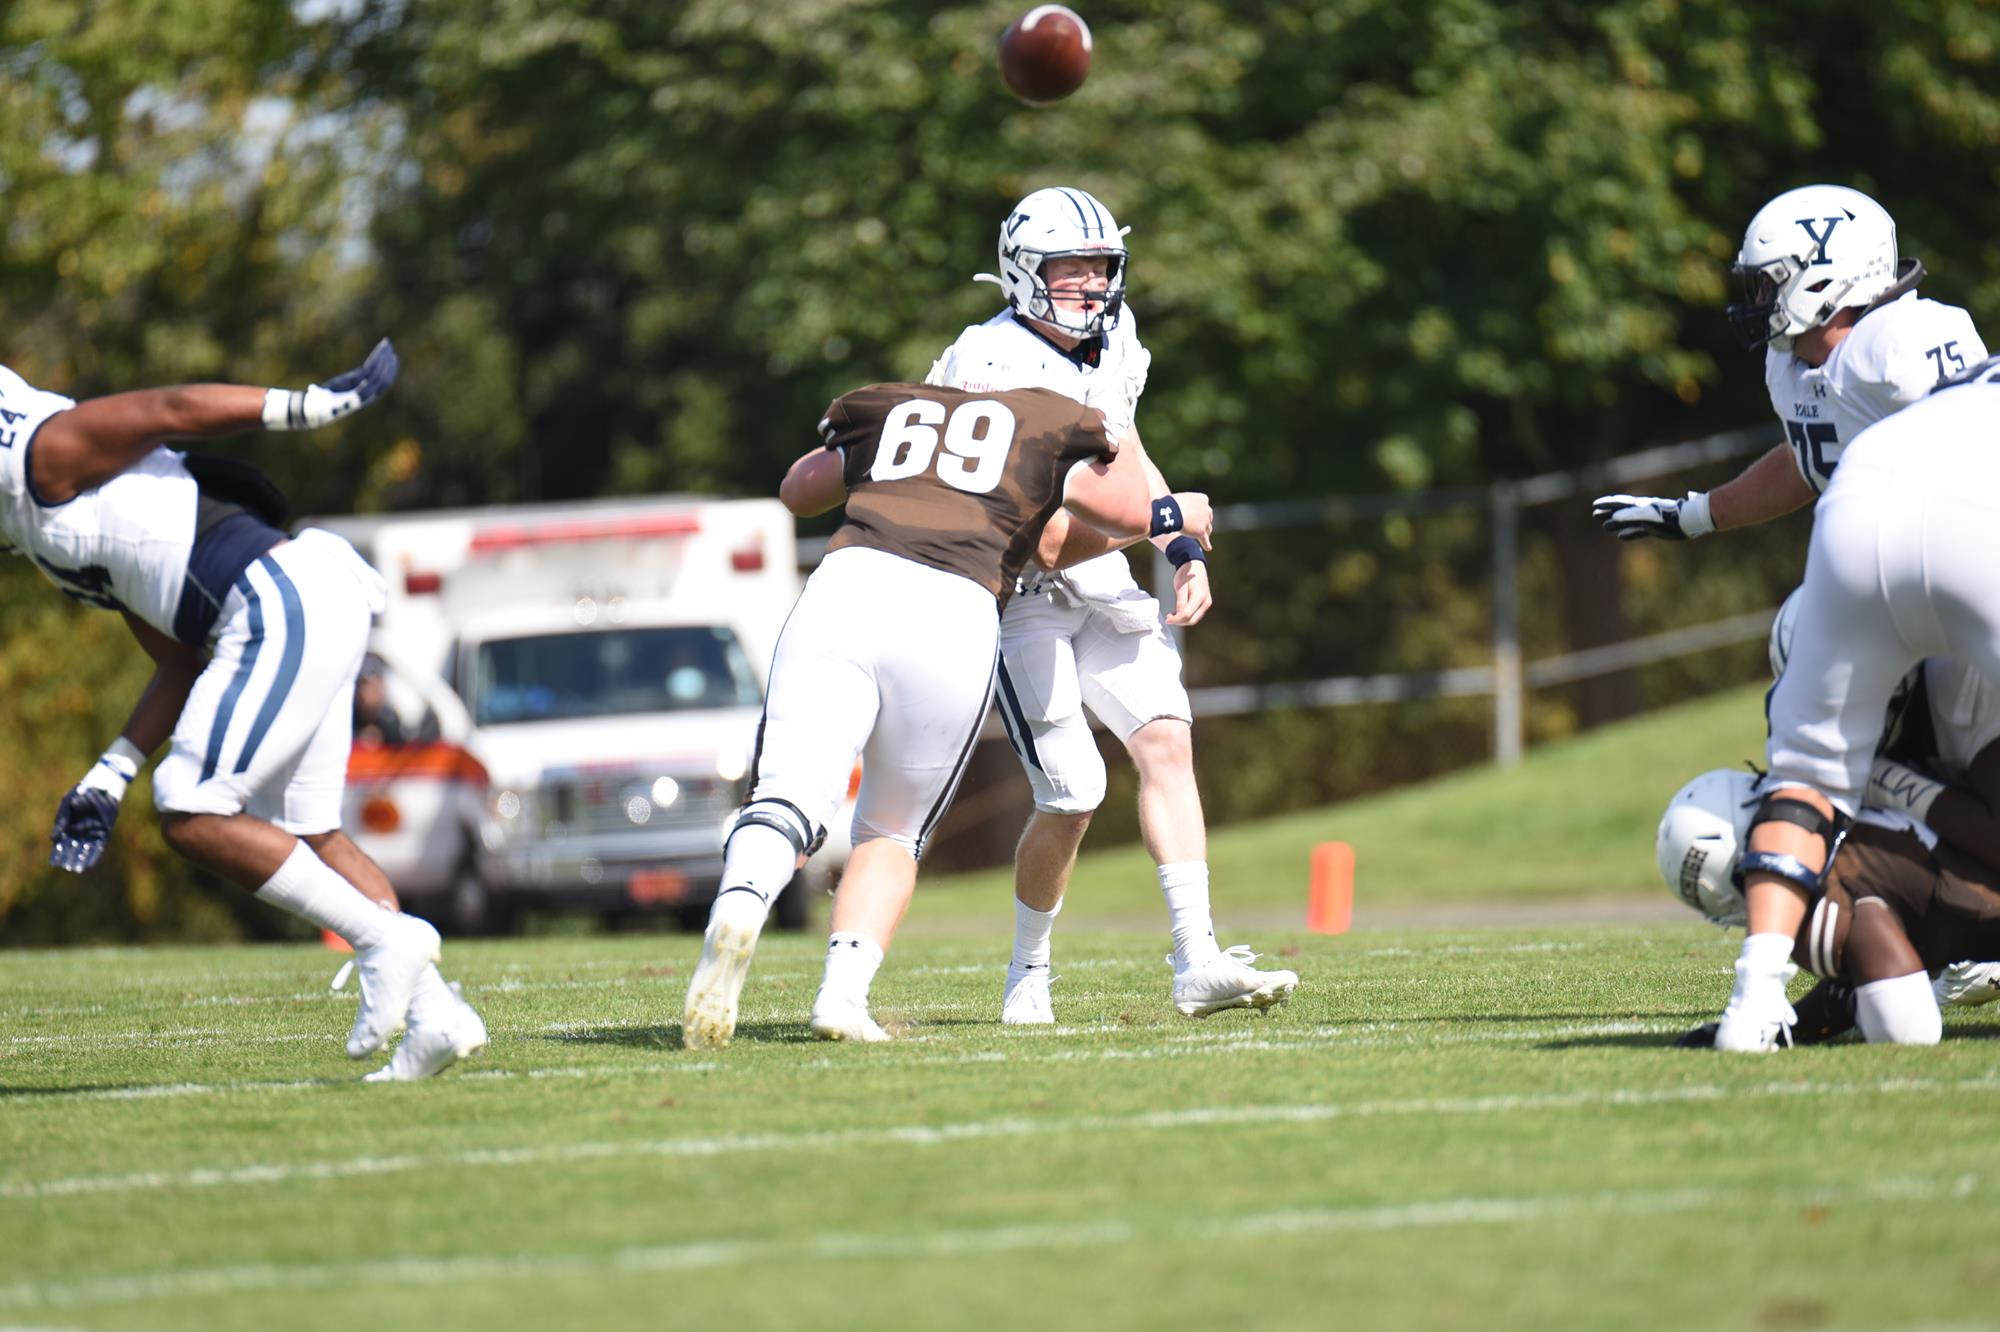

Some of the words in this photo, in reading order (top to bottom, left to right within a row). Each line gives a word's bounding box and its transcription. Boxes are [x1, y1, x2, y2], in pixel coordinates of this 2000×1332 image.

[1794, 216, 1844, 265] Y
[1925, 339, 1967, 386] 75
[1794, 403, 1820, 418] YALE
[871, 398, 1016, 494] 69
